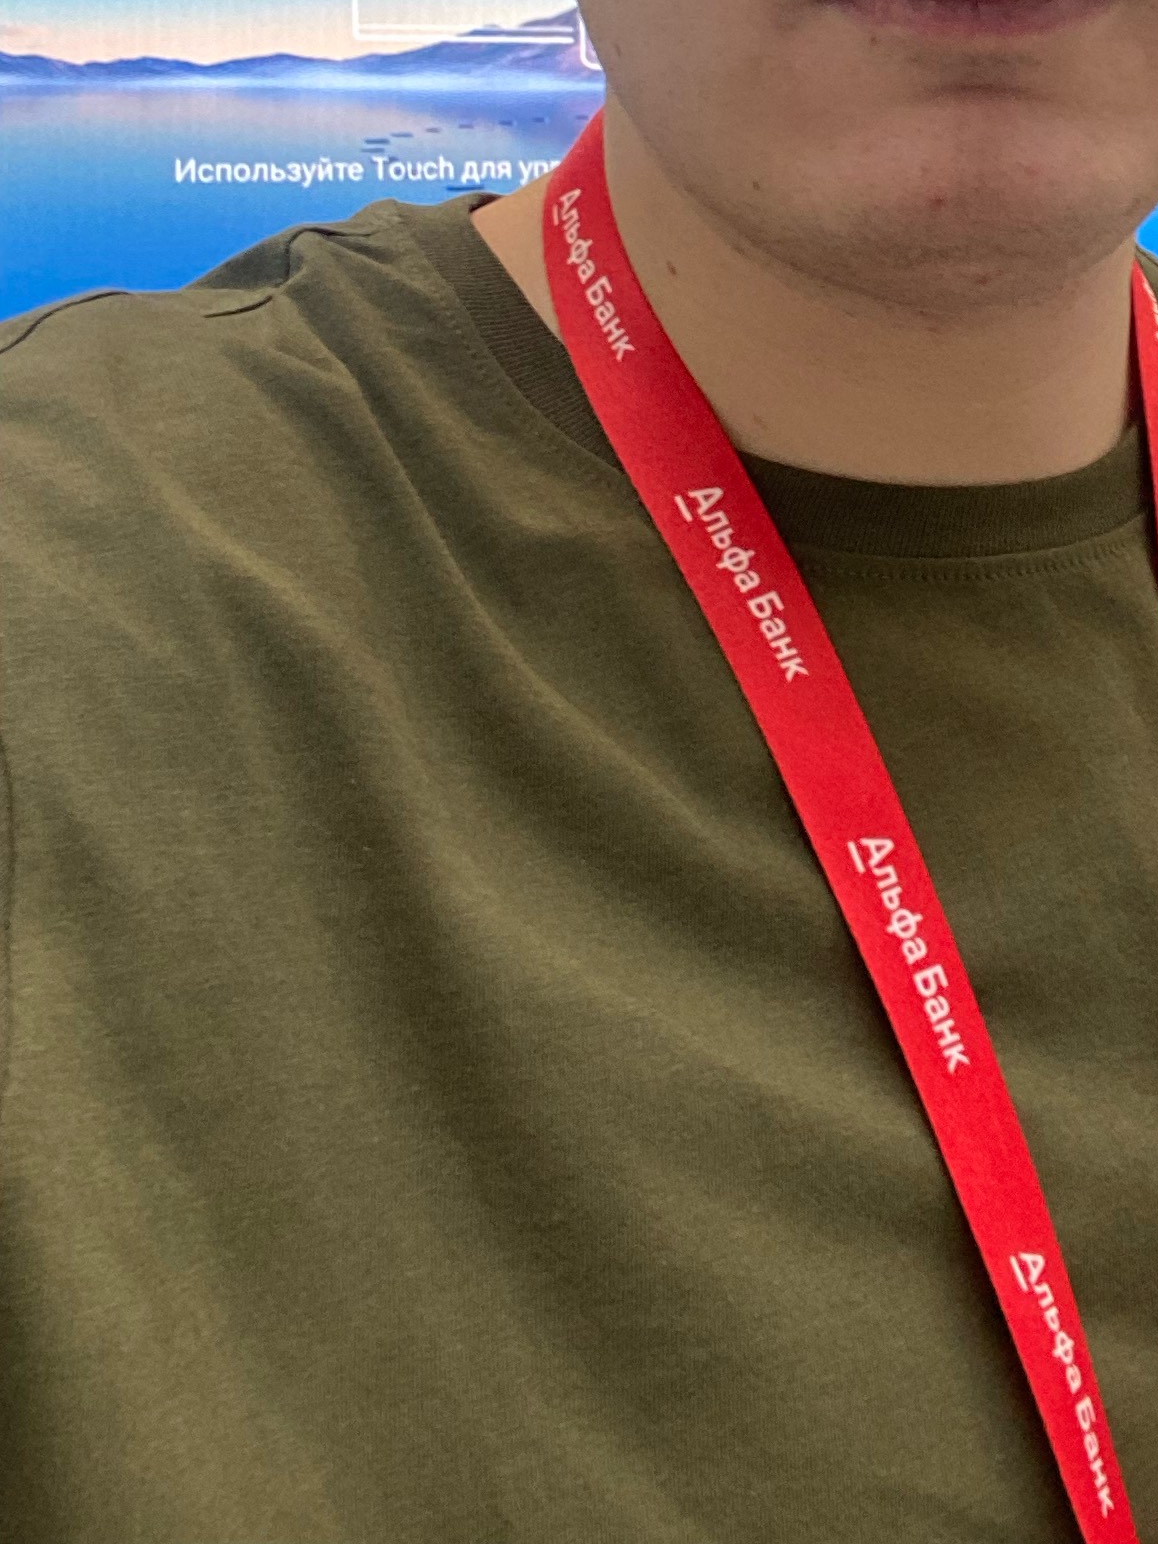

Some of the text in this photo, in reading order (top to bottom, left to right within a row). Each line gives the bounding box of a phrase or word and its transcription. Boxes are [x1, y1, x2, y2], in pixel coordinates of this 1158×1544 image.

[174, 157, 364, 188] Используйте
[372, 155, 455, 182] Touch
[460, 159, 512, 184] для
[552, 188, 635, 362] Альфа Банк
[674, 486, 809, 683] Альфа Банк
[847, 837, 970, 1074] Альфа Банк
[1009, 1252, 1114, 1518] Альфа Банк
